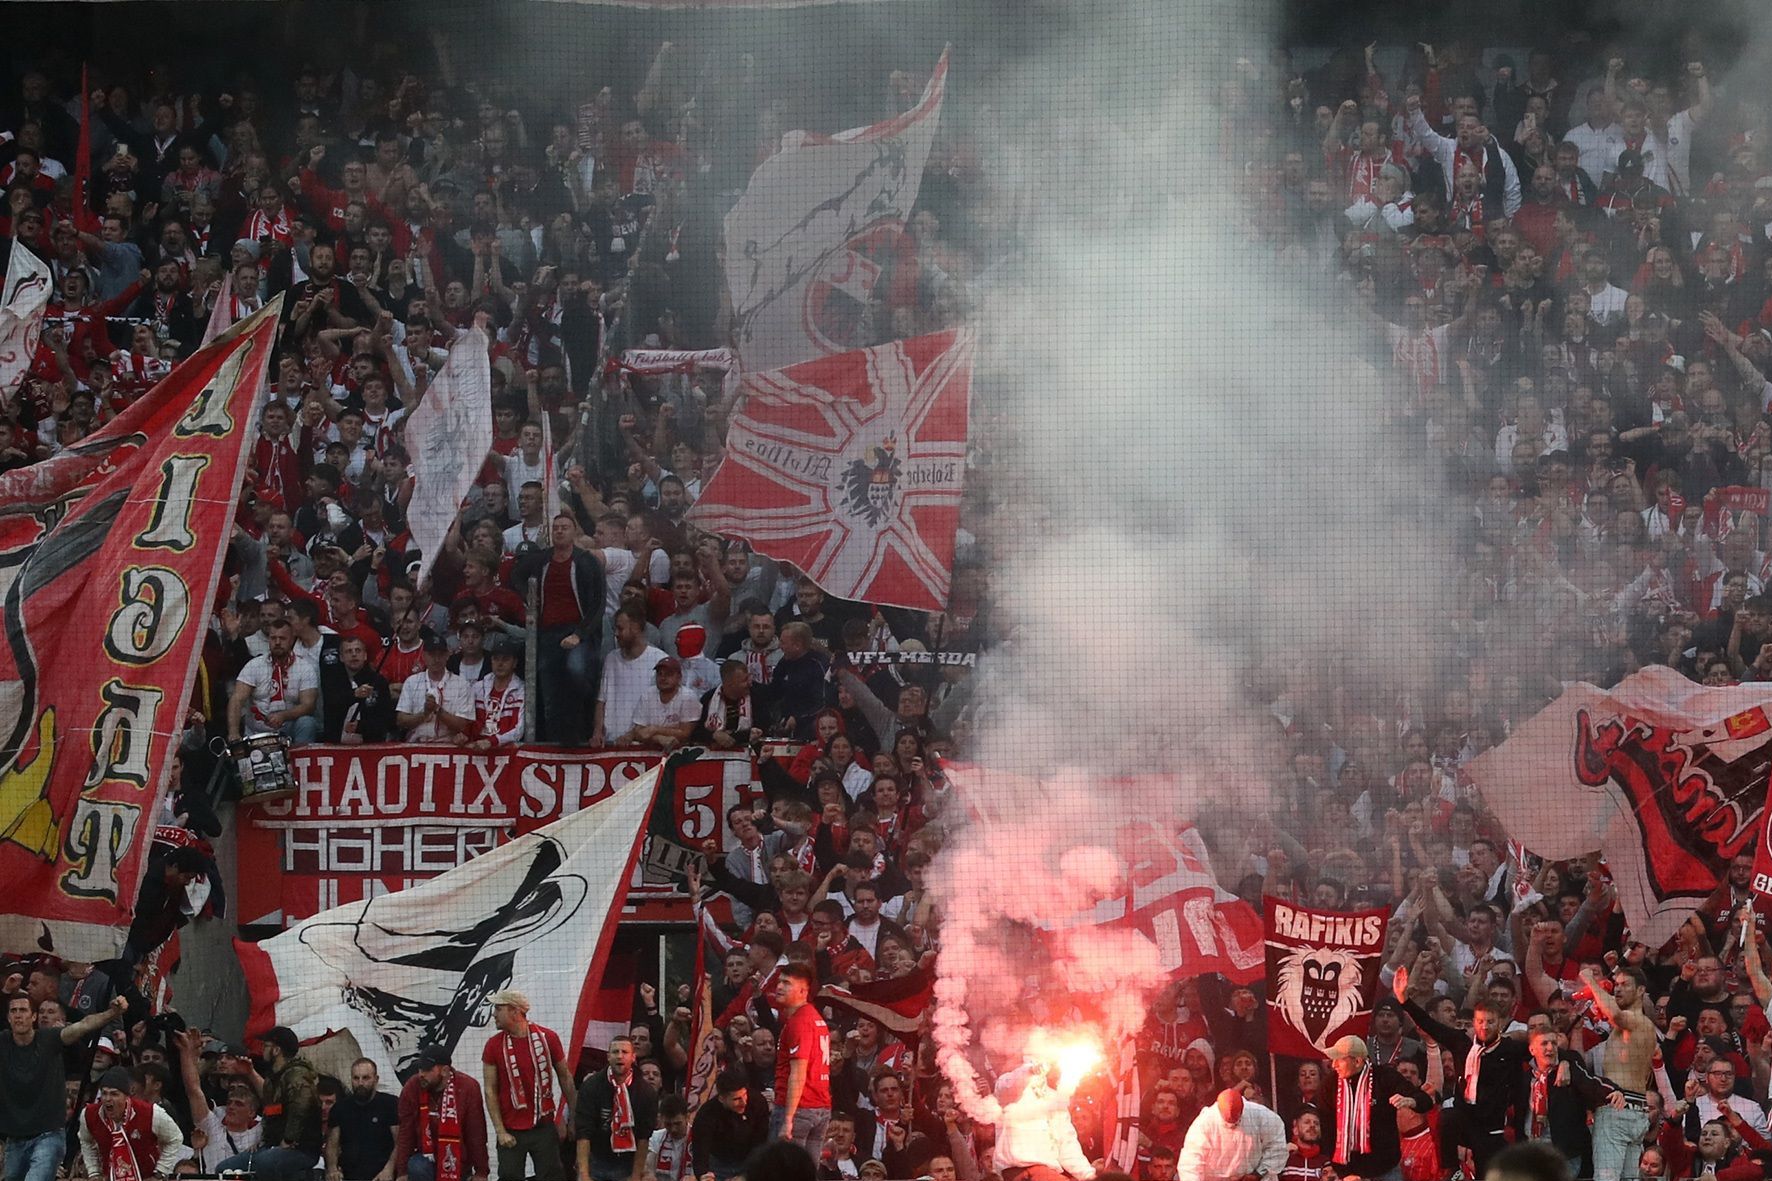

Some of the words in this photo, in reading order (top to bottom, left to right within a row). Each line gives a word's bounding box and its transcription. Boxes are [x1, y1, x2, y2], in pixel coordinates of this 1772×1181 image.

[846, 651, 892, 667] VFL
[899, 651, 977, 668] MERDA
[1274, 903, 1381, 947] RAFIKIS
